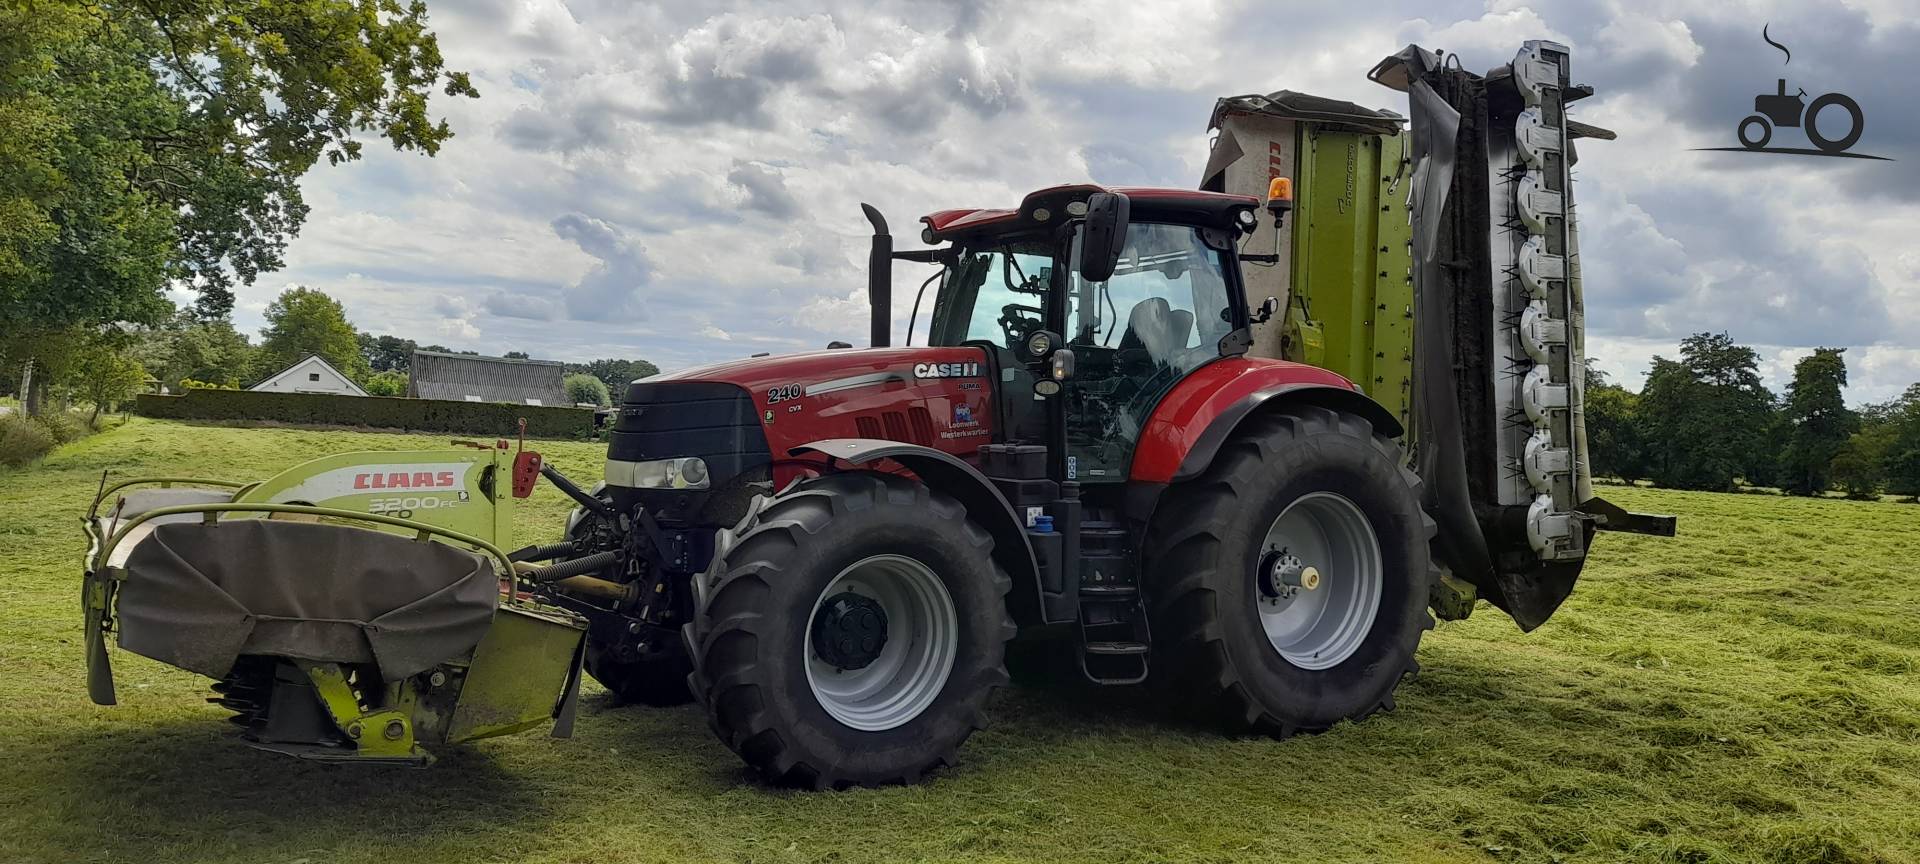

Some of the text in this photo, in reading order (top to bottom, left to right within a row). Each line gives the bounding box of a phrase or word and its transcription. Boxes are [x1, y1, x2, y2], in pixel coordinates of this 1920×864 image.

[914, 363, 961, 378] CASE
[767, 383, 802, 404] 240
[788, 404, 802, 413] CVX
[948, 420, 979, 429] Loonwerk
[354, 472, 454, 490] CLAAS
